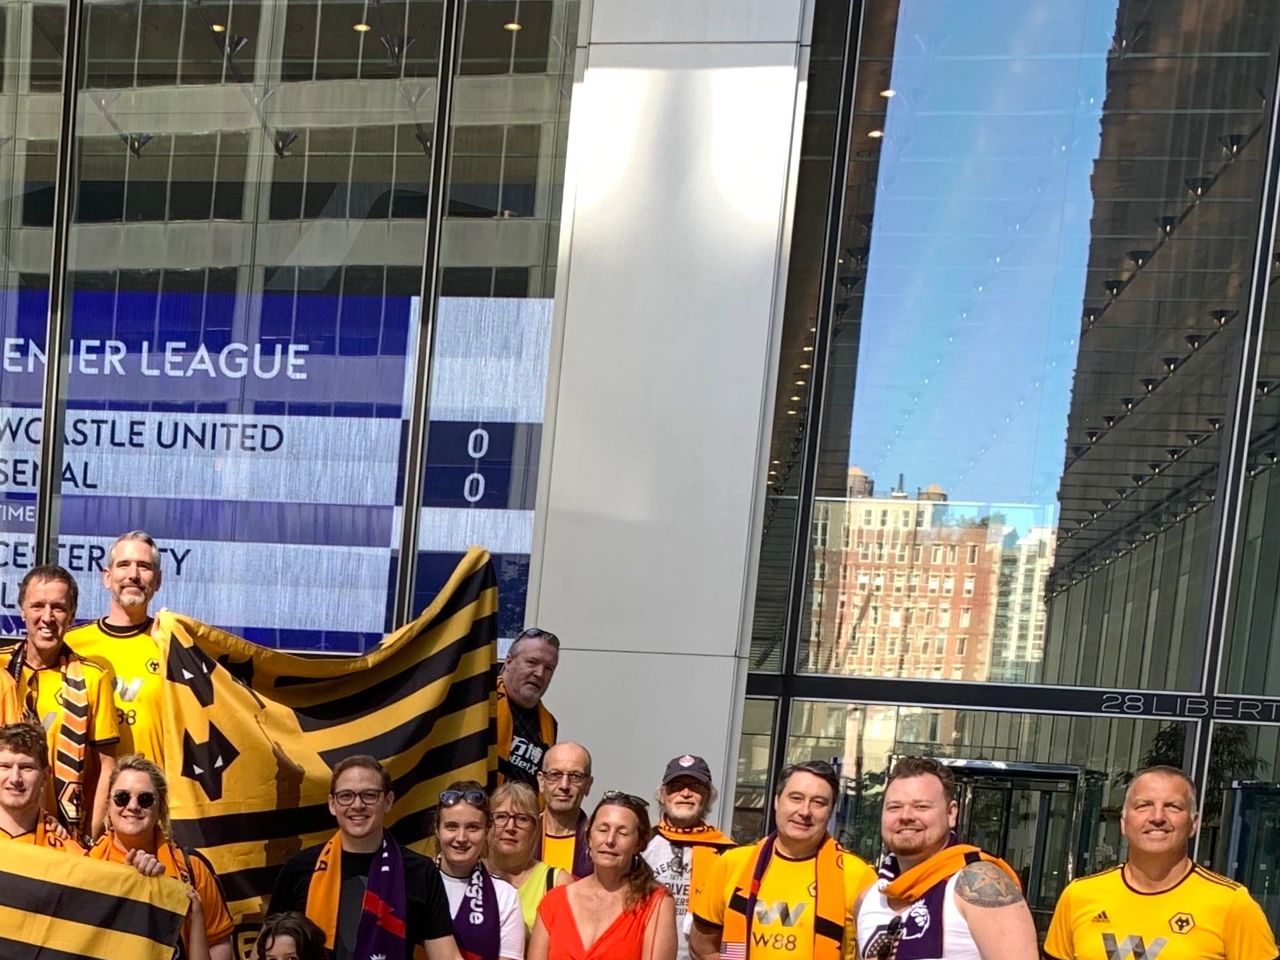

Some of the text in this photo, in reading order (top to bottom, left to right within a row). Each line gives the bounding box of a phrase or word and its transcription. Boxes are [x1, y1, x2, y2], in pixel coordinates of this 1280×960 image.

[140, 340, 310, 380] LEAGUE
[156, 421, 284, 452] UNITED
[467, 428, 489, 459] 0
[463, 472, 485, 502] 0
[1101, 693, 1145, 713] 28
[752, 931, 797, 951] W88
